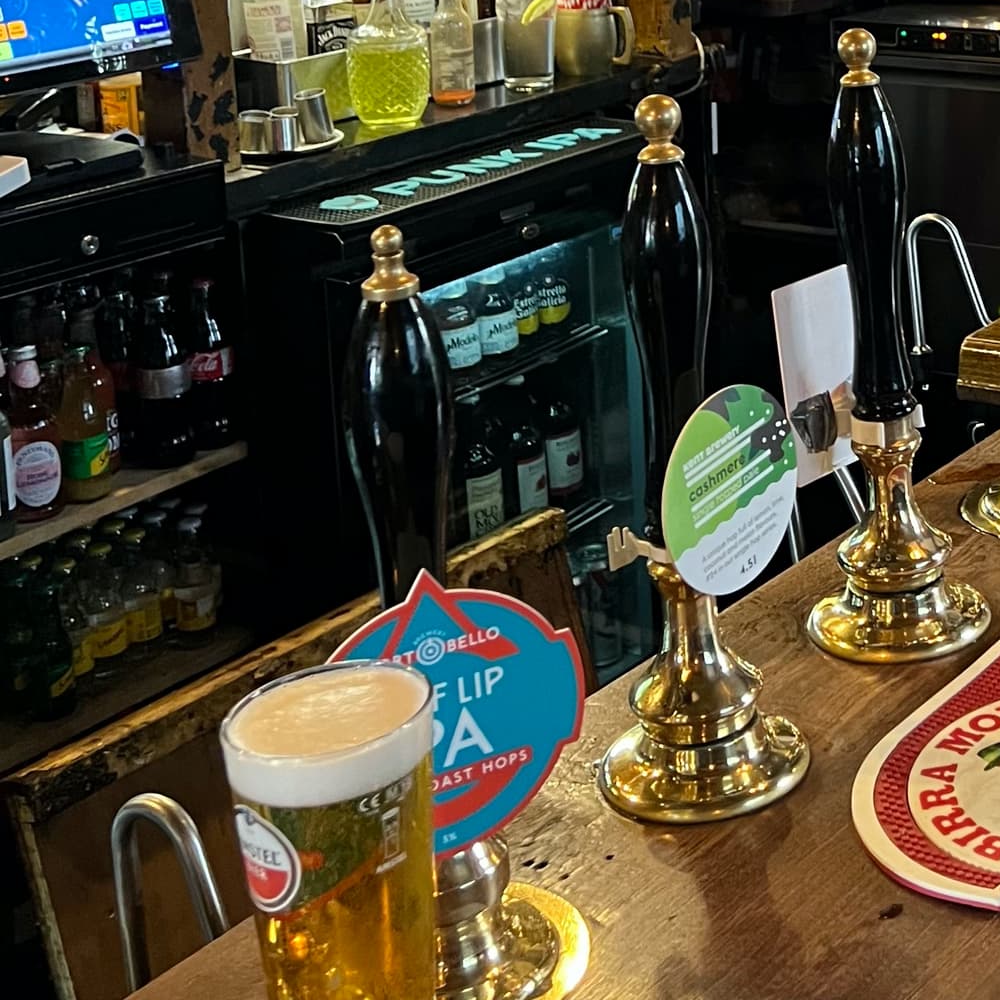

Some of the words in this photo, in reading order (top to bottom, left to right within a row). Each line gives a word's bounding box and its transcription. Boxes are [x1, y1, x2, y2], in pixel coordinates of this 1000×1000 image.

[317, 29, 334, 47] JACK
[372, 149, 544, 197] PUNK
[524, 127, 623, 151] IPA
[536, 284, 568, 297] strella
[538, 295, 568, 308] alicia
[688, 453, 747, 502] cashmere
[457, 666, 504, 704] LIP
[433, 706, 495, 768] PA
[433, 767, 474, 791] OAST
[481, 748, 529, 775] HOPS
[243, 842, 282, 866] STEL
